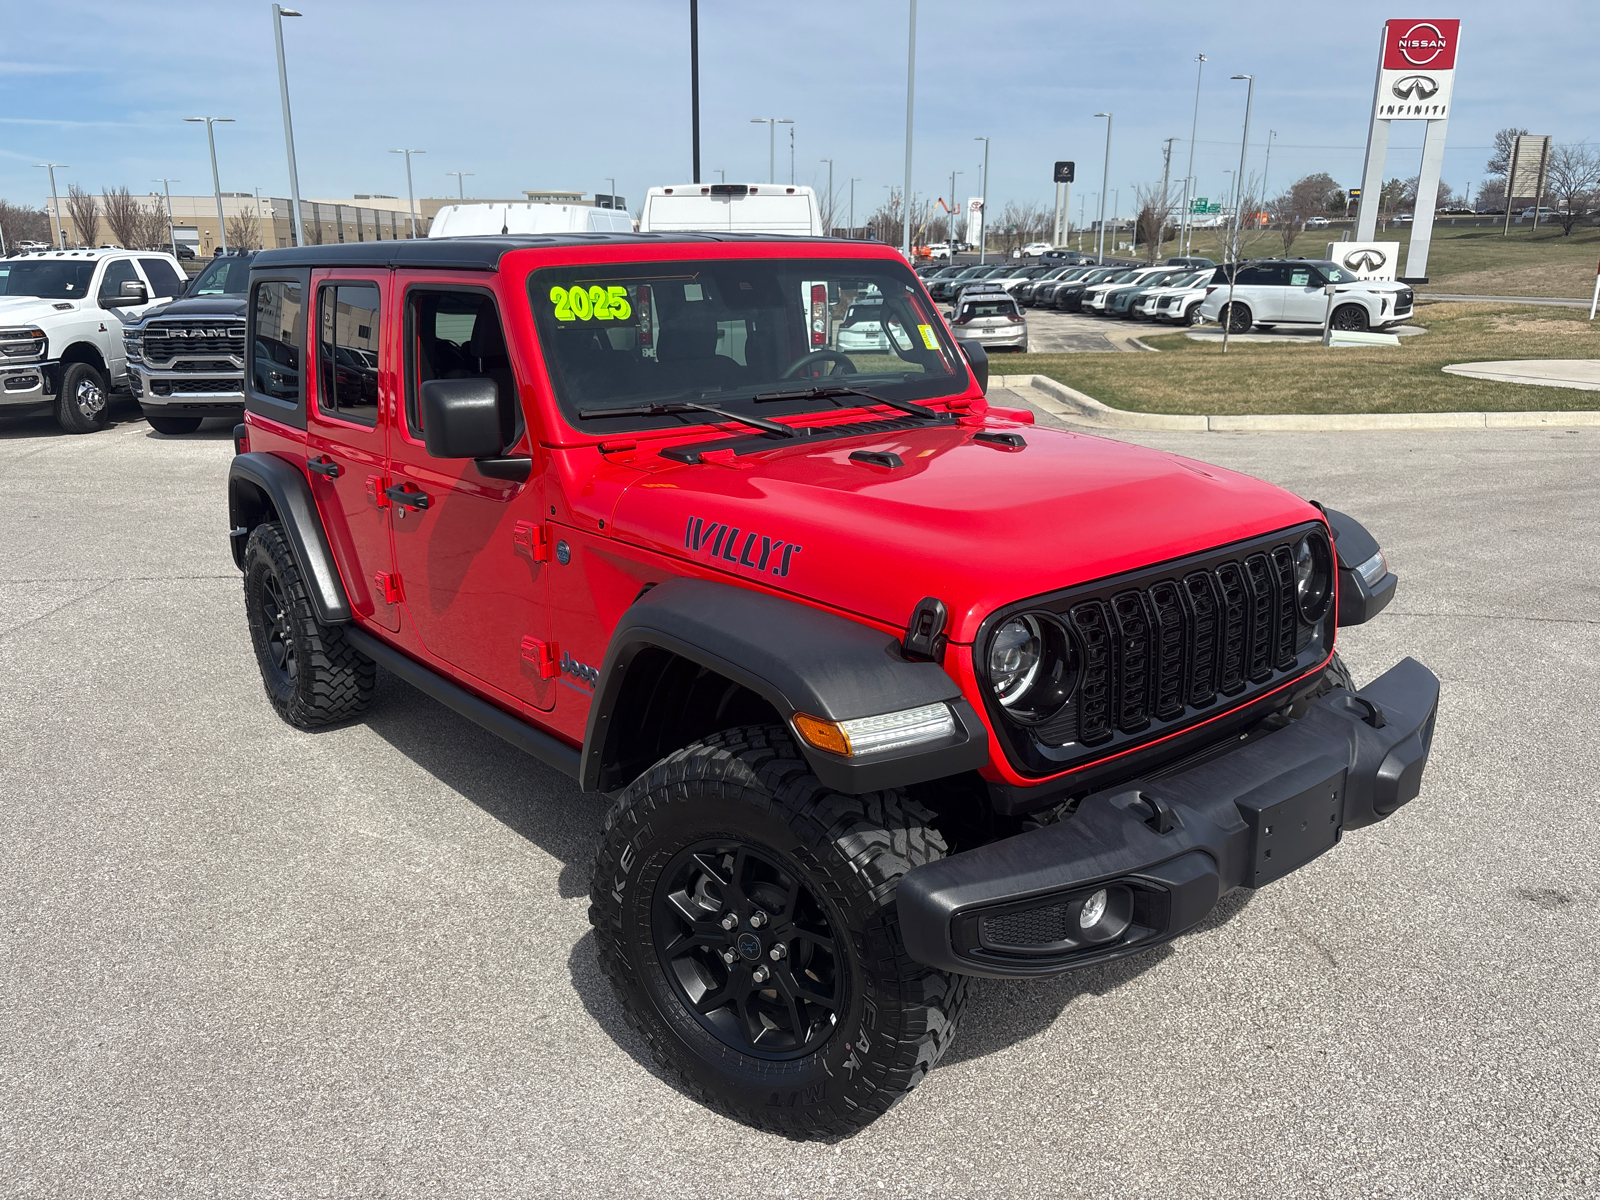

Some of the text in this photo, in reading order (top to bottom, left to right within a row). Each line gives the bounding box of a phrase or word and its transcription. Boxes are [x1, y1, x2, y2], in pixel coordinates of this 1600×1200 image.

[1398, 40, 1446, 48] NISSAN
[1379, 105, 1446, 115] INFINITI
[550, 285, 631, 321] 2025
[169, 328, 226, 338] RAM
[685, 515, 802, 577] WILLYS
[558, 650, 600, 690] Jeep
